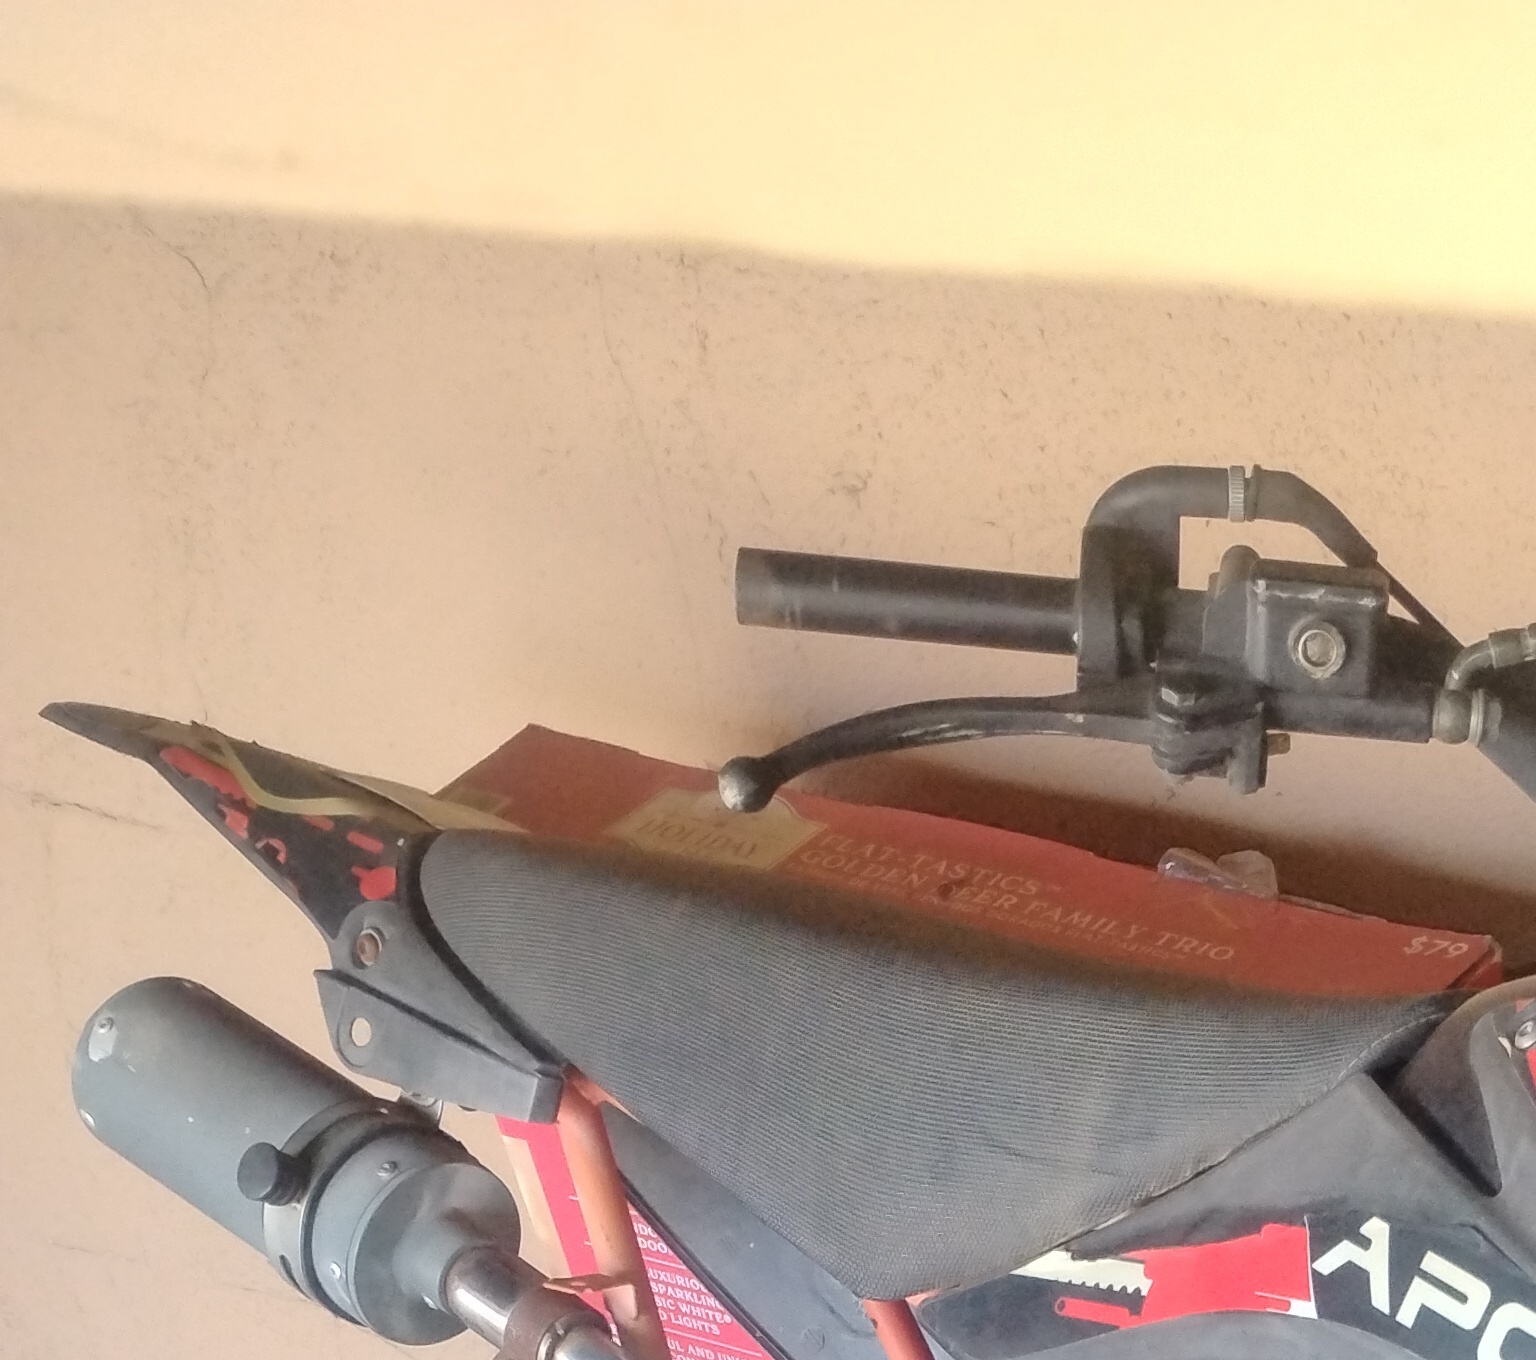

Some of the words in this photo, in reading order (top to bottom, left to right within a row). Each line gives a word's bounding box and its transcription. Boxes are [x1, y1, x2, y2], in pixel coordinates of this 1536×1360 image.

[801, 849, 929, 888] GOLDEN
[930, 880, 1018, 910] DEER
[1023, 900, 1149, 940] FAMILY
[1154, 929, 1236, 960] TRIO
[1403, 935, 1469, 958] $79
[670, 1313, 720, 1335] LIGHTS
[688, 1344, 715, 1360] AND
